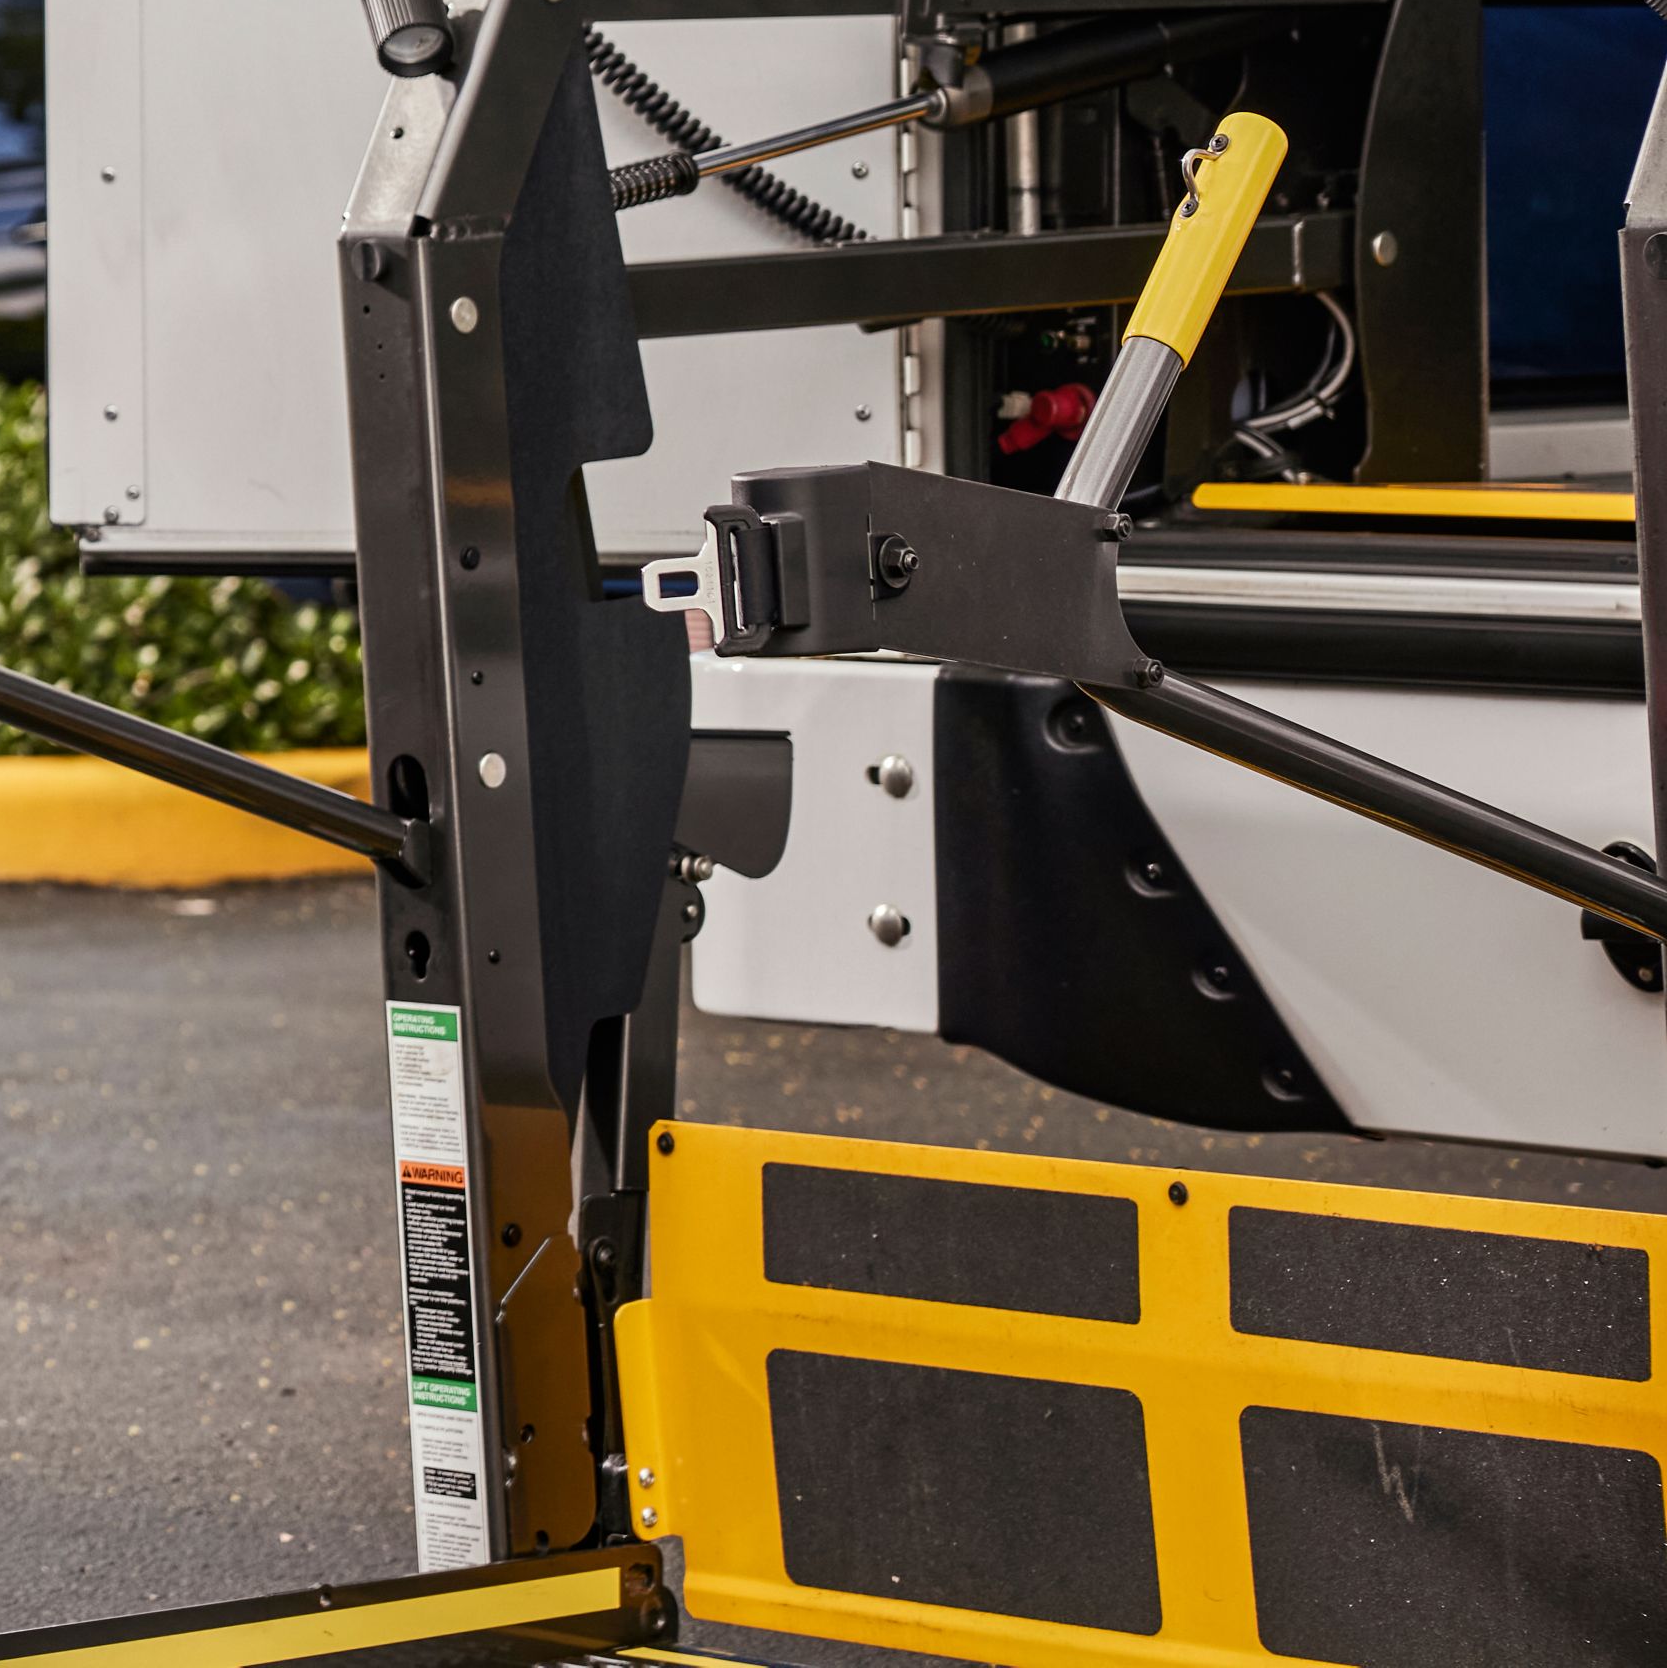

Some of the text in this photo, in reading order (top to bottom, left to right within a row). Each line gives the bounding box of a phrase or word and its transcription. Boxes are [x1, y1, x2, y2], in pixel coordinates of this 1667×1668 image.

[393, 1013, 435, 1025] OPERATING
[393, 1023, 446, 1035] INSTRUCTIONS
[411, 1166, 463, 1183] WARNING
[413, 1381, 471, 1397] LIFT OPERATING
[413, 1392, 466, 1406] INSTRUCTIONS
